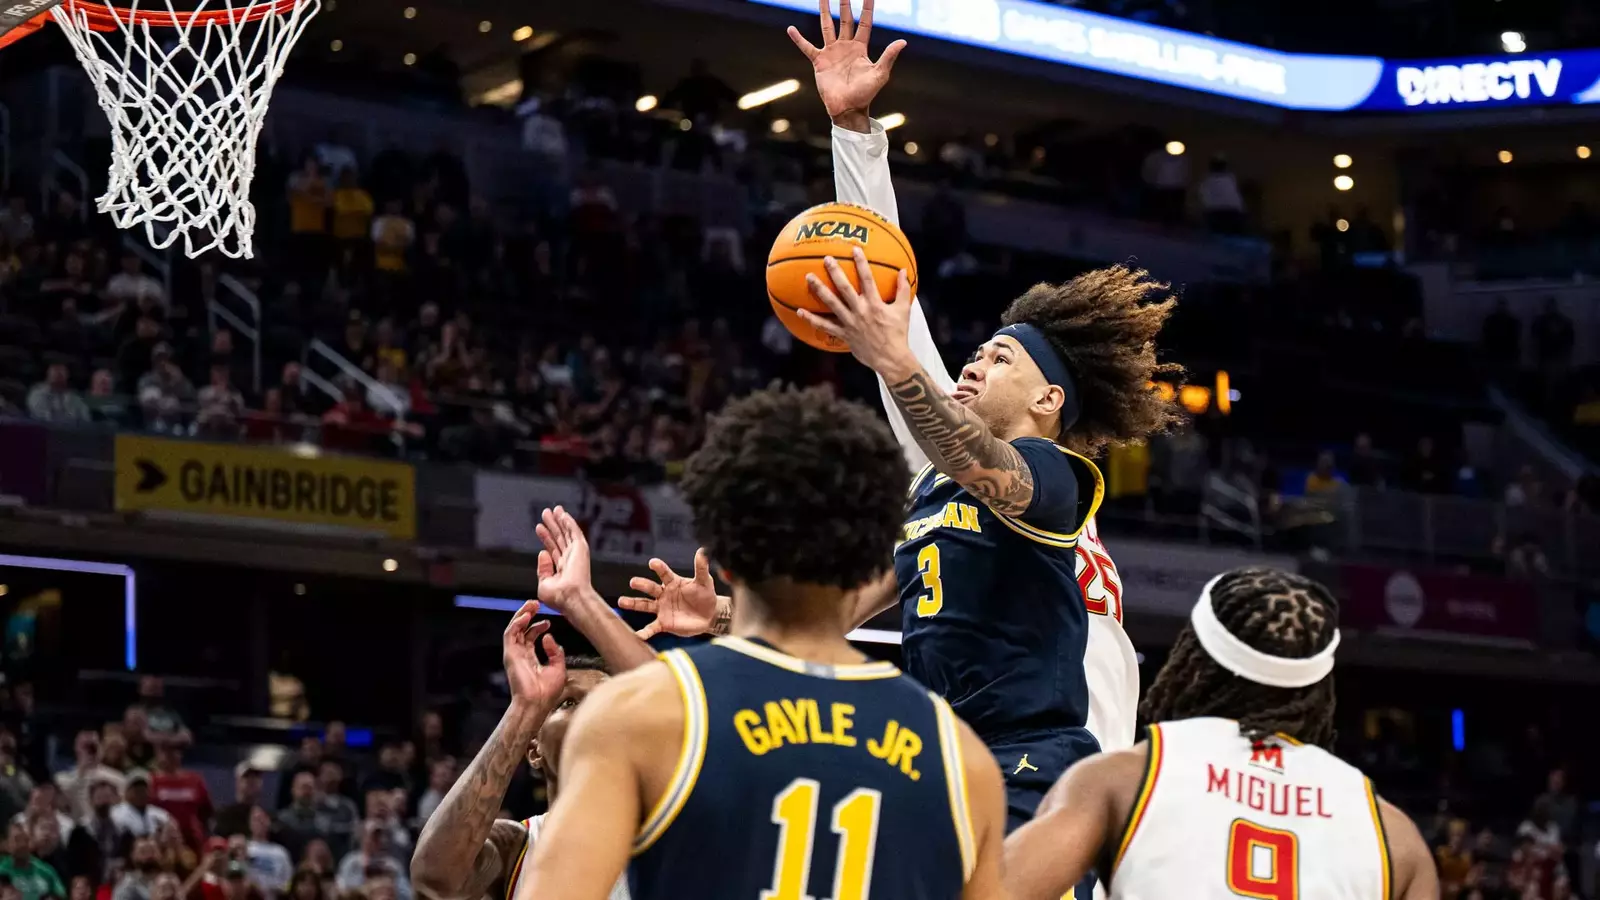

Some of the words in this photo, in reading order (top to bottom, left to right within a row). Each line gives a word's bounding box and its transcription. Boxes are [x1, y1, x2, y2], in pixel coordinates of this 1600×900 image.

[1397, 59, 1562, 106] DIRECTV
[796, 221, 869, 247] NCAA
[180, 460, 400, 521] GAINBRIDGE
[917, 543, 943, 618] 3
[1075, 545, 1123, 625] 25
[734, 698, 857, 755] GAYLE
[866, 720, 923, 781] JR.
[1251, 741, 1285, 770] M
[1206, 763, 1332, 818] MIGUEL
[759, 777, 882, 900] 11
[1226, 817, 1299, 900] 9
